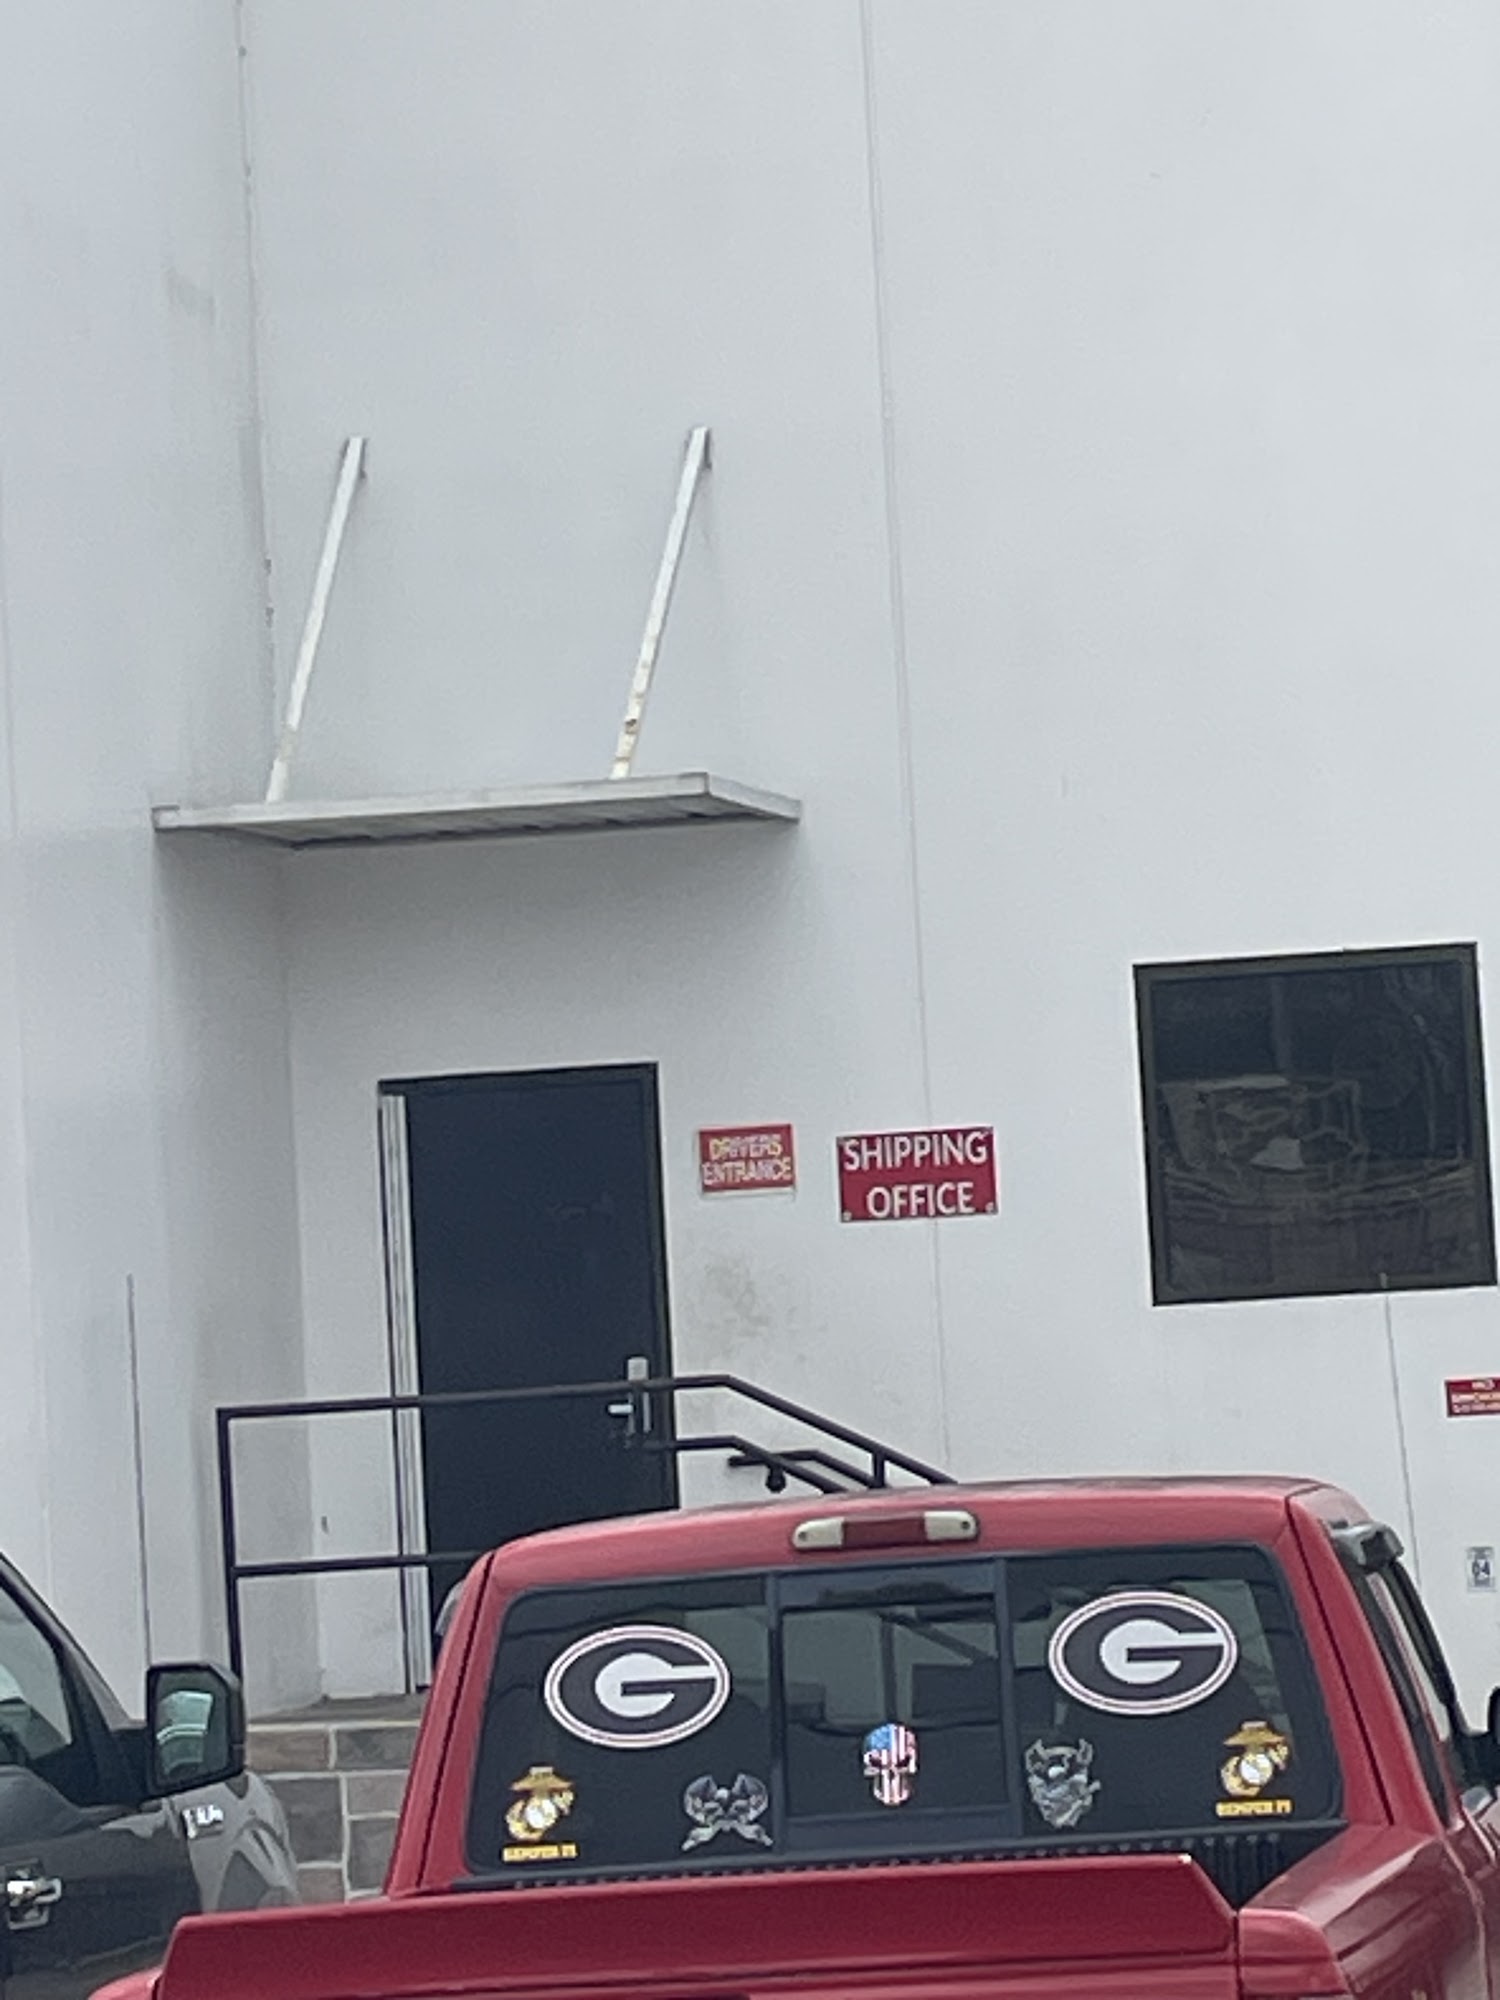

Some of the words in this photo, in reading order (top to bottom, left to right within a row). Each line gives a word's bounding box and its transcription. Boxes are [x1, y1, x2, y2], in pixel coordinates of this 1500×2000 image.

[702, 1157, 792, 1185] ENTRANCE
[844, 1131, 988, 1171] SHIPPING
[866, 1182, 976, 1218] OFFICE
[1100, 1618, 1224, 1684] G
[594, 1652, 716, 1718] G
